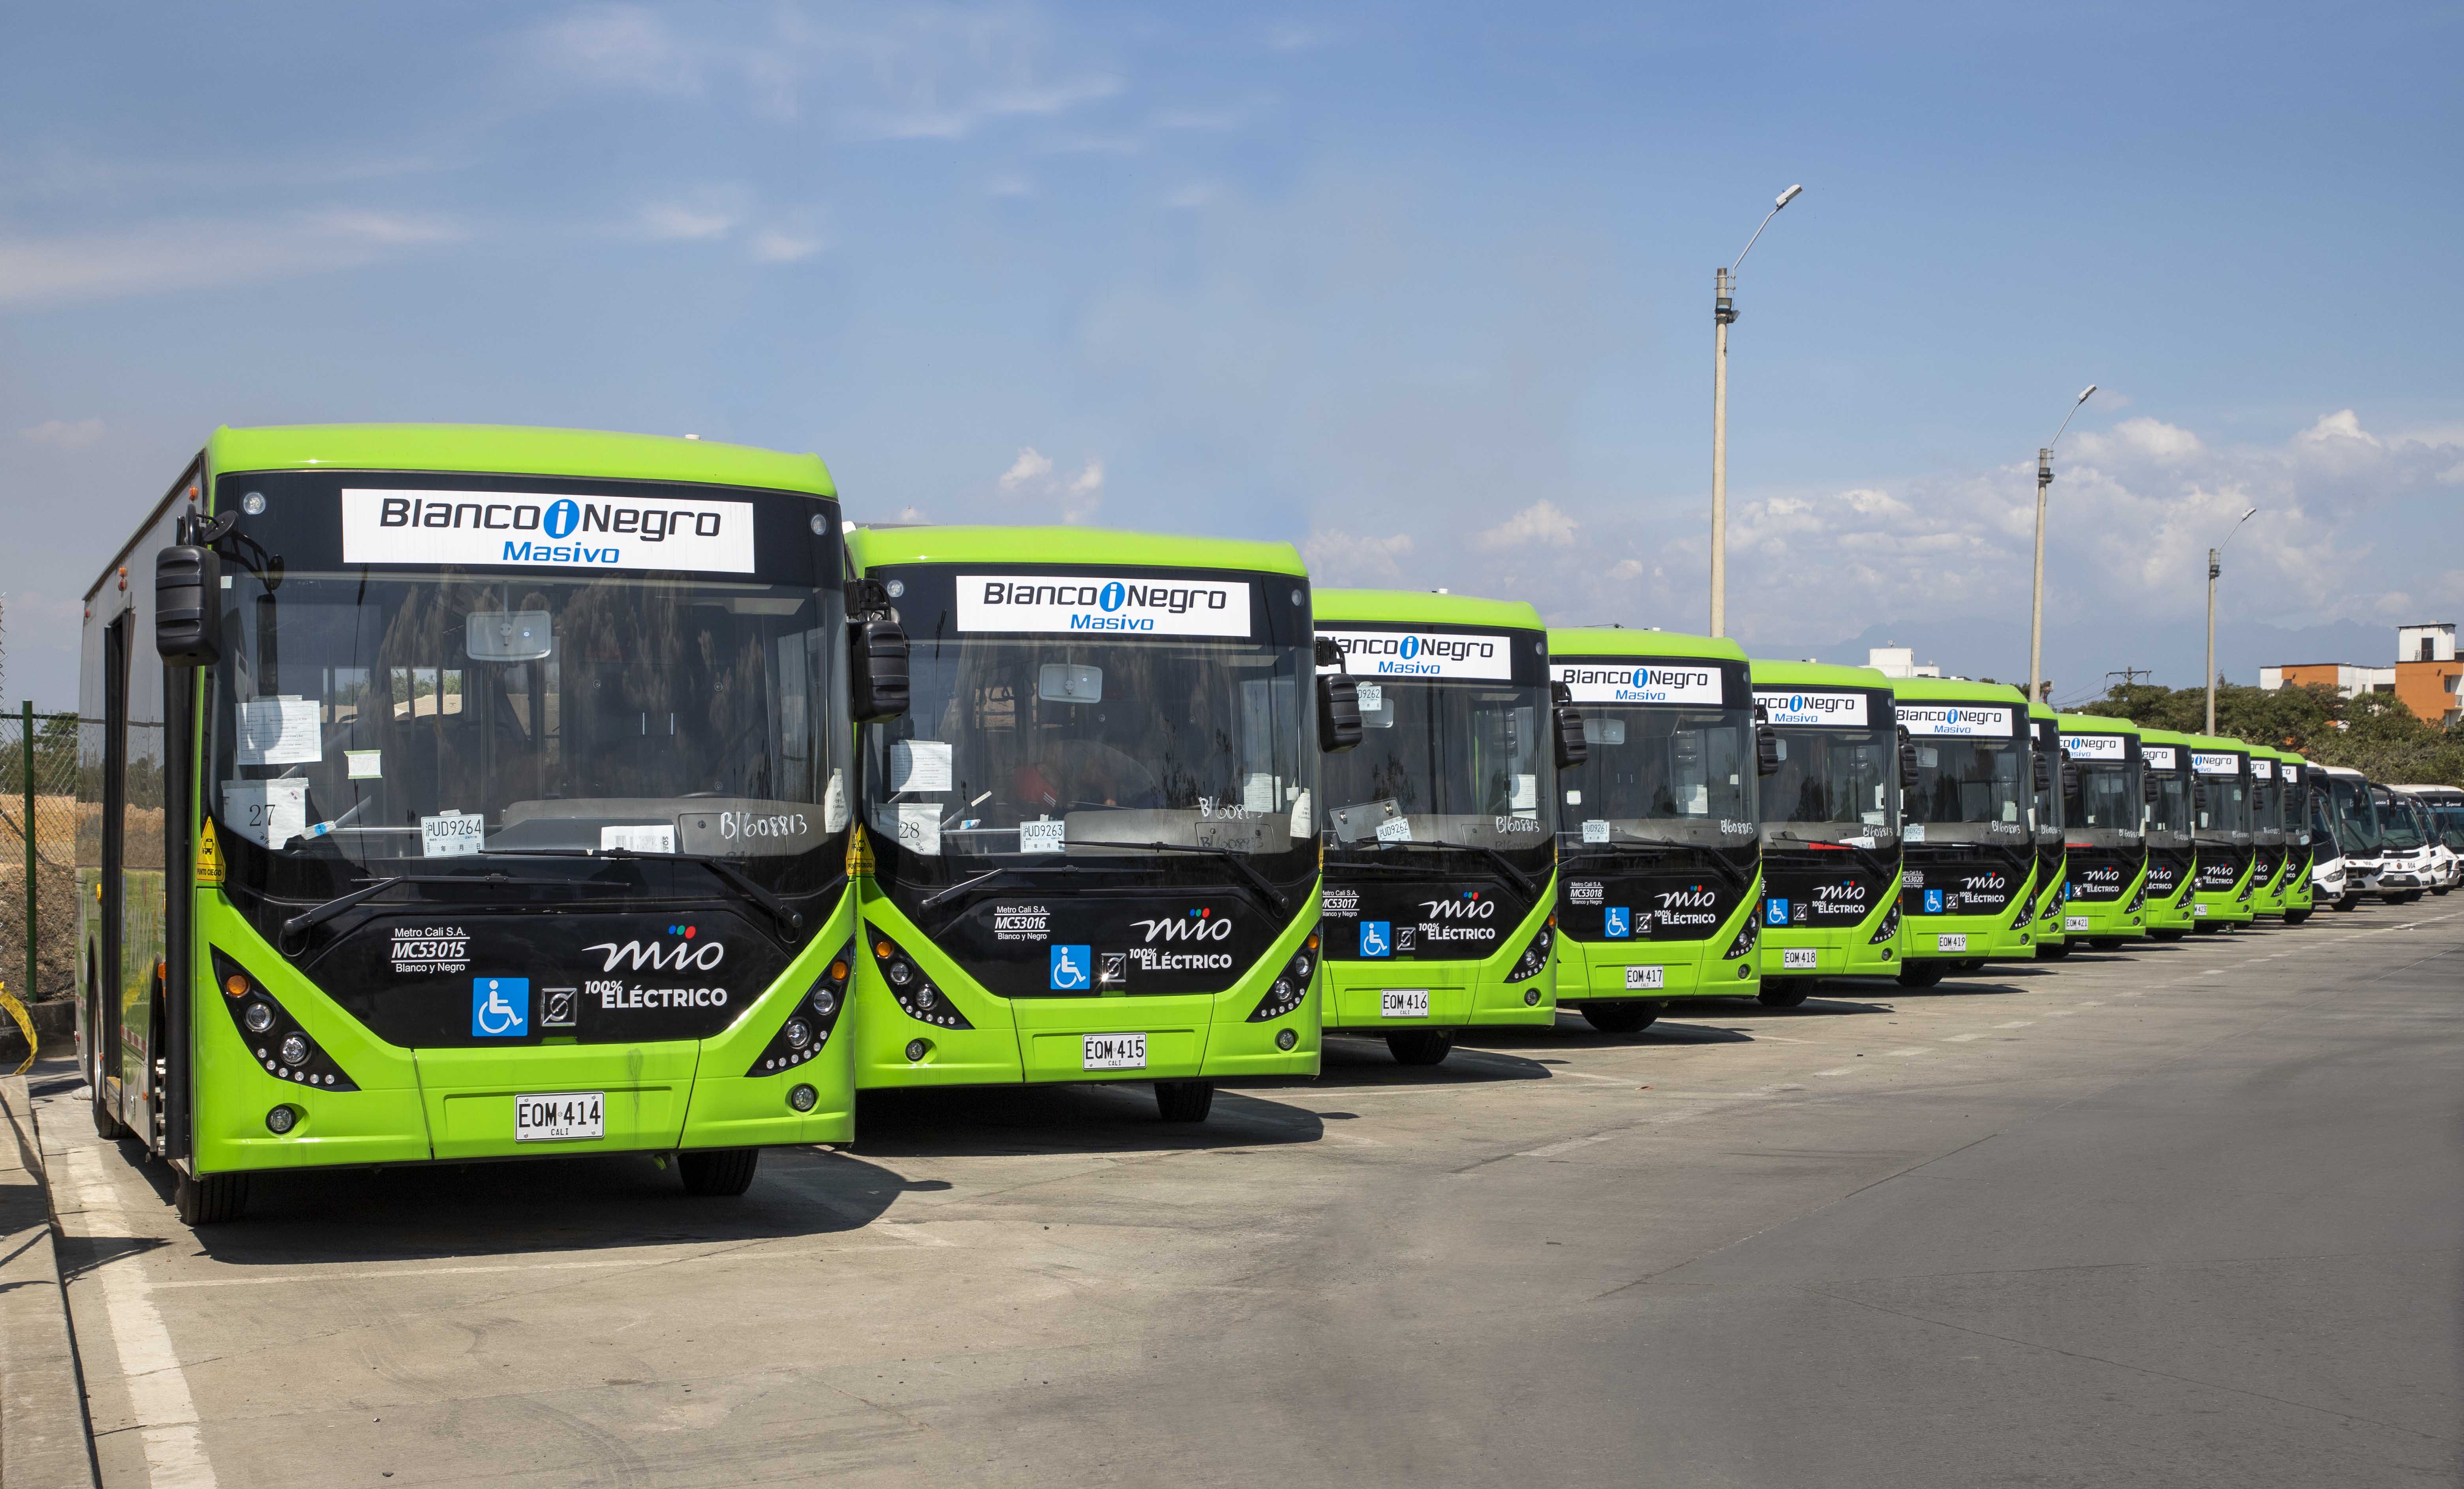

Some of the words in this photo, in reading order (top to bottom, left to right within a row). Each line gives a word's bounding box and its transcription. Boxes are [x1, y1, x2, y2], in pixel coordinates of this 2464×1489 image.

[380, 498, 539, 530] Blanco
[582, 504, 721, 541] Negro
[503, 541, 620, 563] Masivo
[983, 582, 1097, 605] Blanco
[1127, 585, 1226, 613] Negro
[1070, 615, 1153, 630] Masivo
[1421, 639, 1493, 661] Negro
[1378, 661, 1440, 674] Masivo
[1563, 669, 1631, 684] Blanco
[1649, 671, 1708, 689] Negro
[1616, 690, 1665, 700] Masivo
[1804, 697, 1854, 713] Negro
[1775, 714, 1818, 722] Masivo
[1896, 710, 1946, 721] Blanco
[1959, 711, 2002, 724] Negro
[1934, 725, 1971, 733] Masivo
[2081, 739, 2116, 750] Negro
[2143, 751, 2167, 760] egro
[2203, 757, 2231, 766] Negro
[250, 805, 275, 827] 27
[900, 822, 920, 838] 28
[1570, 889, 1602, 897] MC53018
[1965, 893, 2004, 903] ELÉCTRICO
[1818, 904, 1865, 913] ELÉCTRICO
[995, 917, 1046, 929] MC53016
[1662, 912, 1716, 925] ELÉCTRICO
[395, 928, 422, 937] Metro
[425, 927, 443, 936] Cali
[446, 927, 466, 936] S.A.
[1027, 933, 1047, 941] Negro
[1428, 926, 1495, 940] ELÉCTRICO
[1953, 937, 1965, 946] 419
[392, 942, 466, 958] MC53015
[1130, 949, 1156, 959] 100%
[1142, 952, 1232, 970] ELÉCTRICO
[1801, 952, 1816, 963] 418
[396, 964, 427, 972] Blanco
[429, 966, 435, 974] y
[438, 963, 465, 973] Negro
[1646, 969, 1662, 982] 417
[585, 980, 623, 994] 100%
[602, 985, 727, 1008] ELÉCTRICO
[1384, 995, 1404, 1009] EQM
[1407, 995, 1427, 1009] 416
[1086, 1041, 1113, 1059] EQM
[1117, 1040, 1144, 1058] 415
[519, 1102, 557, 1128] EQM
[563, 1100, 601, 1126] 414
